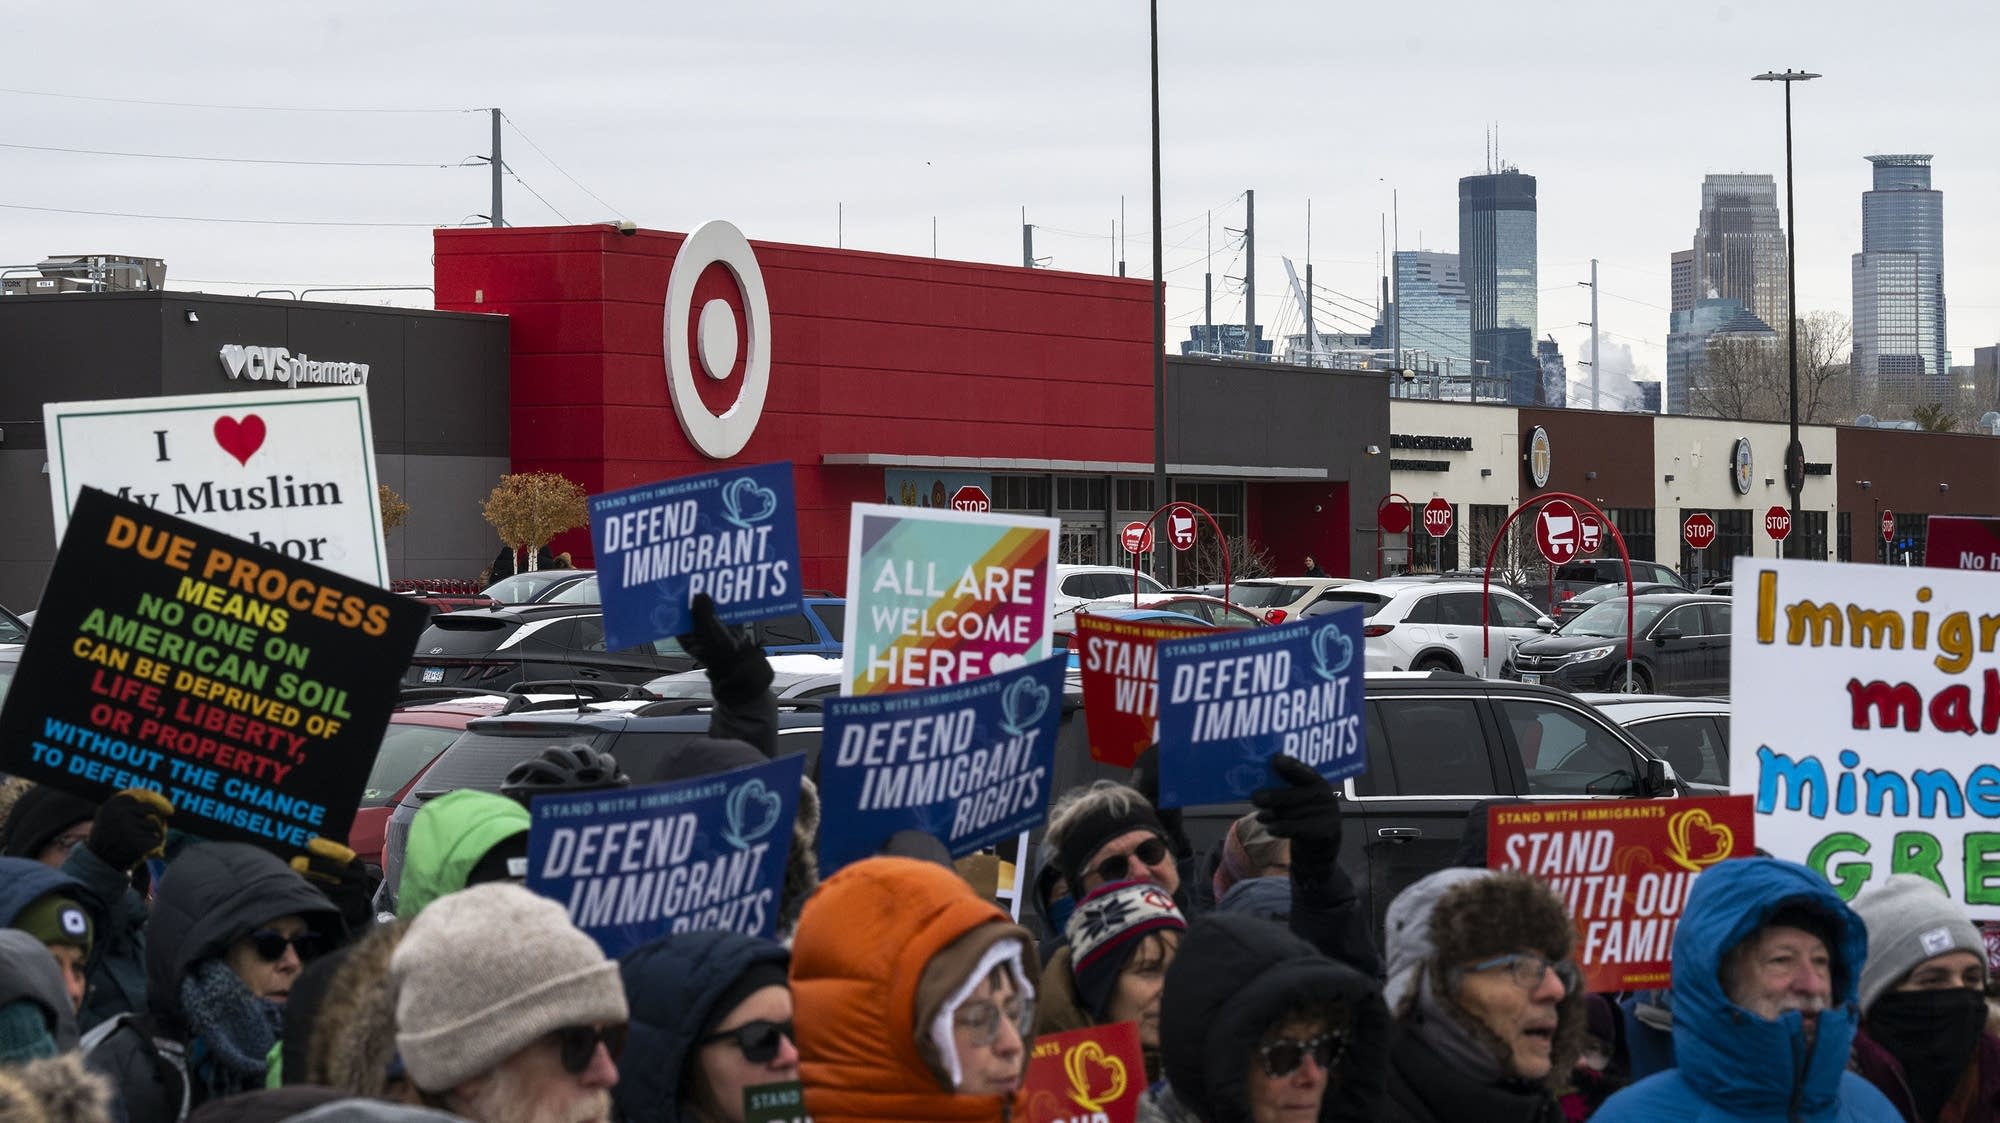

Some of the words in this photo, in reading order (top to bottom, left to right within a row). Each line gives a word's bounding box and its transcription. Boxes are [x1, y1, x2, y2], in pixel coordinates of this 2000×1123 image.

[244, 345, 291, 382] CVS
[287, 353, 370, 389] pharmacy
[153, 430, 171, 462] I
[117, 486, 159, 509] y
[172, 475, 343, 515] Muslim
[595, 497, 627, 512] STAND
[629, 491, 652, 505] WITH
[655, 478, 720, 499] IMMIGRANTS
[955, 500, 988, 513] STOP
[1426, 510, 1451, 525] STOP
[604, 499, 699, 555] DEFEND
[1686, 524, 1714, 537] STOP
[1766, 516, 1790, 530] STOP
[1882, 520, 1894, 533] STOP
[105, 515, 197, 571] DUE
[203, 549, 391, 637] PROCESS
[622, 525, 773, 589] IMMIGRANT
[1960, 551, 1985, 570] No
[176, 576, 290, 634] MEANS
[688, 560, 789, 611] RIGHTS
[873, 558, 946, 598] ALL
[953, 565, 1034, 605] ARE
[136, 593, 185, 627] NO
[192, 612, 259, 652] ONE
[264, 637, 311, 670] ON
[871, 606, 1032, 644] WELCOME
[1081, 619, 1113, 633] STAND
[1115, 624, 1140, 636] WITH
[1142, 629, 1206, 640] IMMIGR
[1165, 643, 1206, 658] STAND
[1209, 638, 1240, 653] WITH
[1243, 626, 1310, 648] IMMIGRANTS
[1757, 570, 2000, 675] Immigr
[79, 607, 269, 690] AMERICAN
[275, 672, 352, 720] SOIL
[867, 644, 984, 688] HERE
[1171, 650, 1291, 704] DEFEND
[73, 637, 130, 671] CAN
[133, 657, 171, 685] BE
[174, 670, 302, 728] DEPRIVED
[305, 714, 342, 740] OF
[832, 703, 880, 716] STAND
[884, 698, 920, 713] WITH
[923, 681, 1001, 706] IMMIGRANTS
[1115, 677, 1159, 718] WIT
[1191, 676, 1350, 743] IMMIGRANT
[91, 669, 166, 719] LIFE,
[174, 697, 308, 765] LIBERTY,
[836, 708, 976, 767] DEFEND
[1282, 714, 1360, 767] RIGHTS
[31, 742, 64, 768] TO
[90, 703, 134, 735] OR
[138, 719, 292, 785] PROPERTY
[43, 717, 164, 773] WITHOUT
[169, 758, 220, 791] THE
[223, 777, 327, 827] CHANCE
[858, 728, 1041, 811] IMMIGRANT
[541, 804, 593, 819] STAND
[597, 798, 637, 814] WITH
[640, 782, 727, 809] IMMIGRANTS
[950, 766, 1045, 841] RIGHTS
[1498, 812, 1541, 825] STAND
[1544, 810, 1578, 823] WITH
[1582, 806, 1666, 821] IMMIGRANTS
[541, 812, 698, 879] DEFEND
[1501, 829, 1614, 876] STAND
[1807, 831, 2000, 905] GRE
[568, 841, 769, 928] IMMIGRANT
[1583, 919, 1680, 965] FAMI
